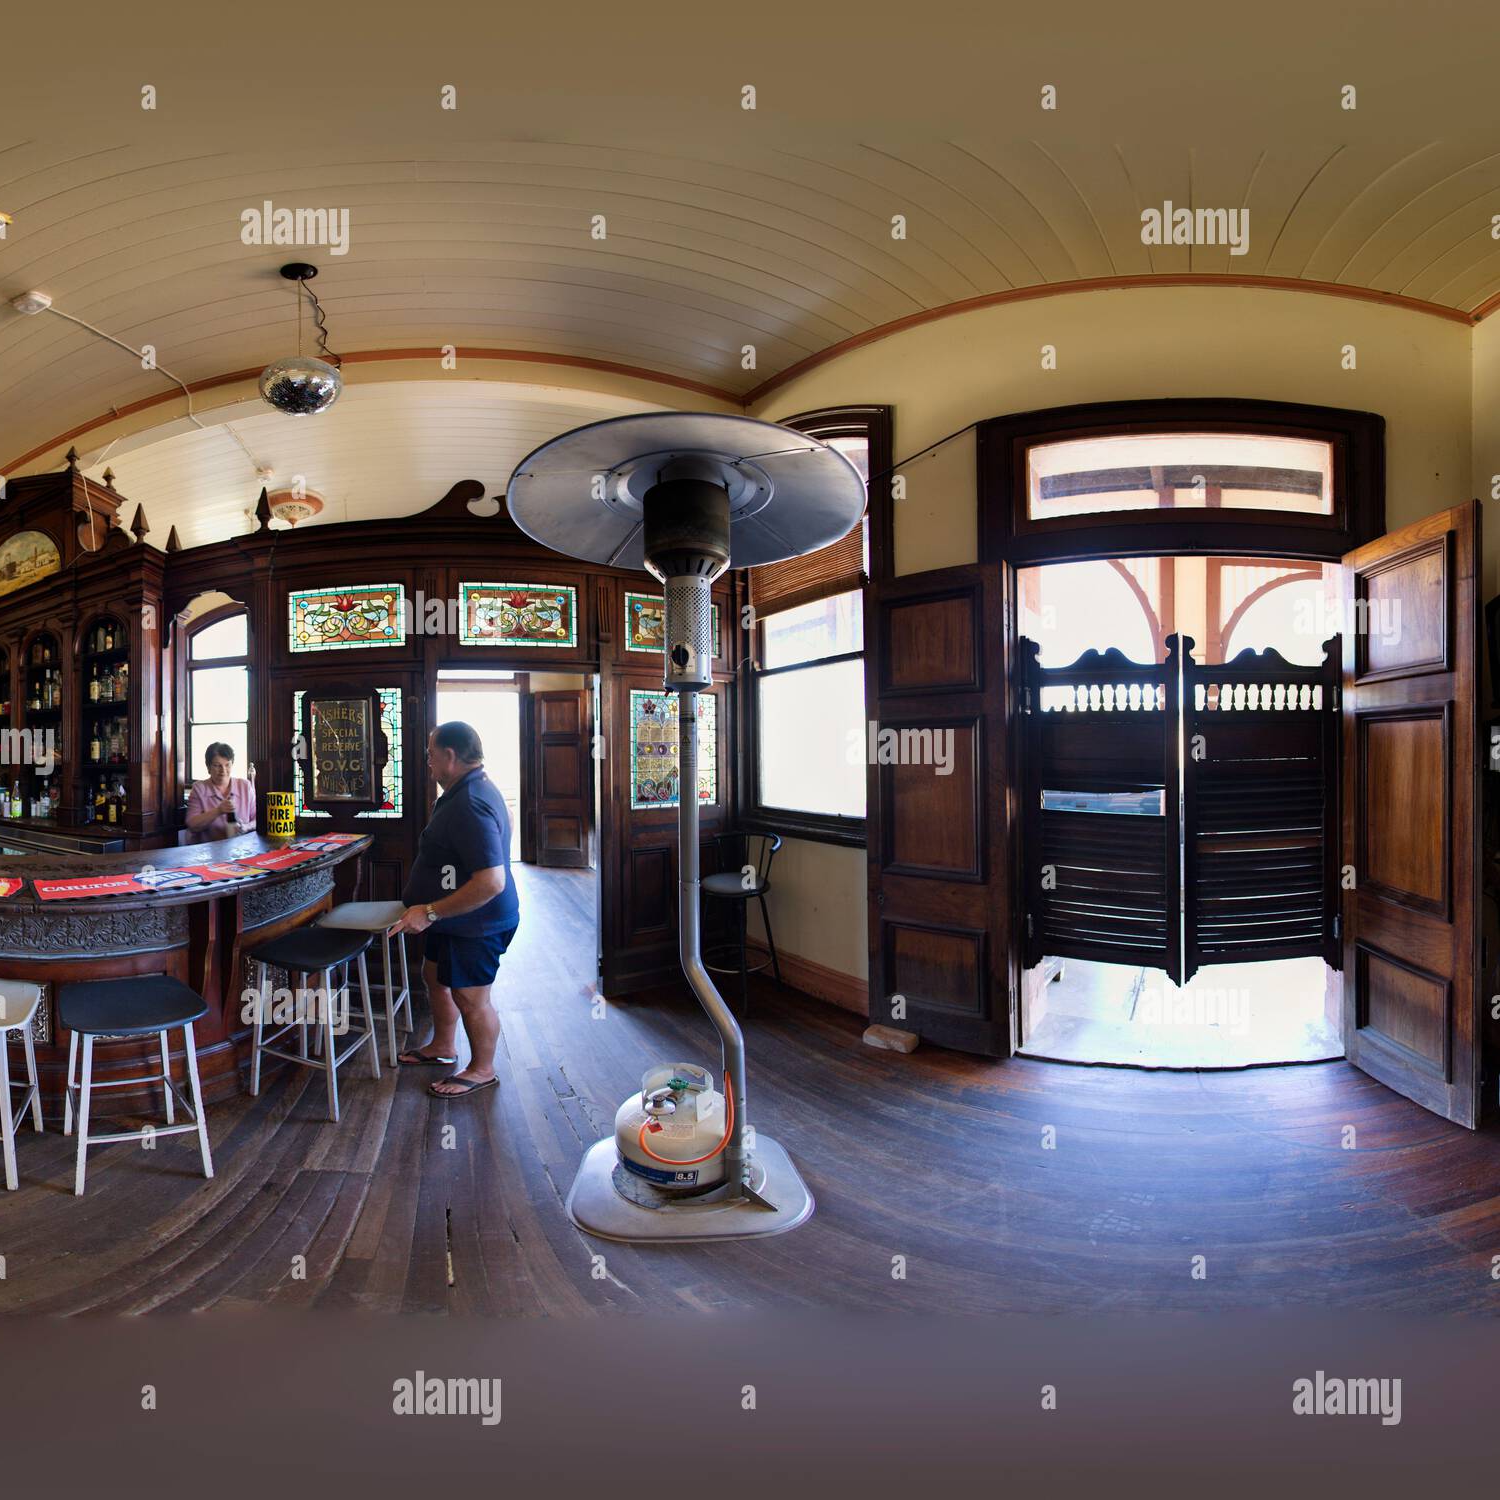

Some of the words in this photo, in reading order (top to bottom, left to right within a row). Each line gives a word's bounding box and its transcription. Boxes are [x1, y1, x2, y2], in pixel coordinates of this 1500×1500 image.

[323, 728, 359, 738] SPECIAL
[322, 742, 360, 752] RESERVE
[270, 809, 290, 820] FIRE
[42, 881, 129, 892] CARLTON
[676, 1172, 694, 1180] 8.5
